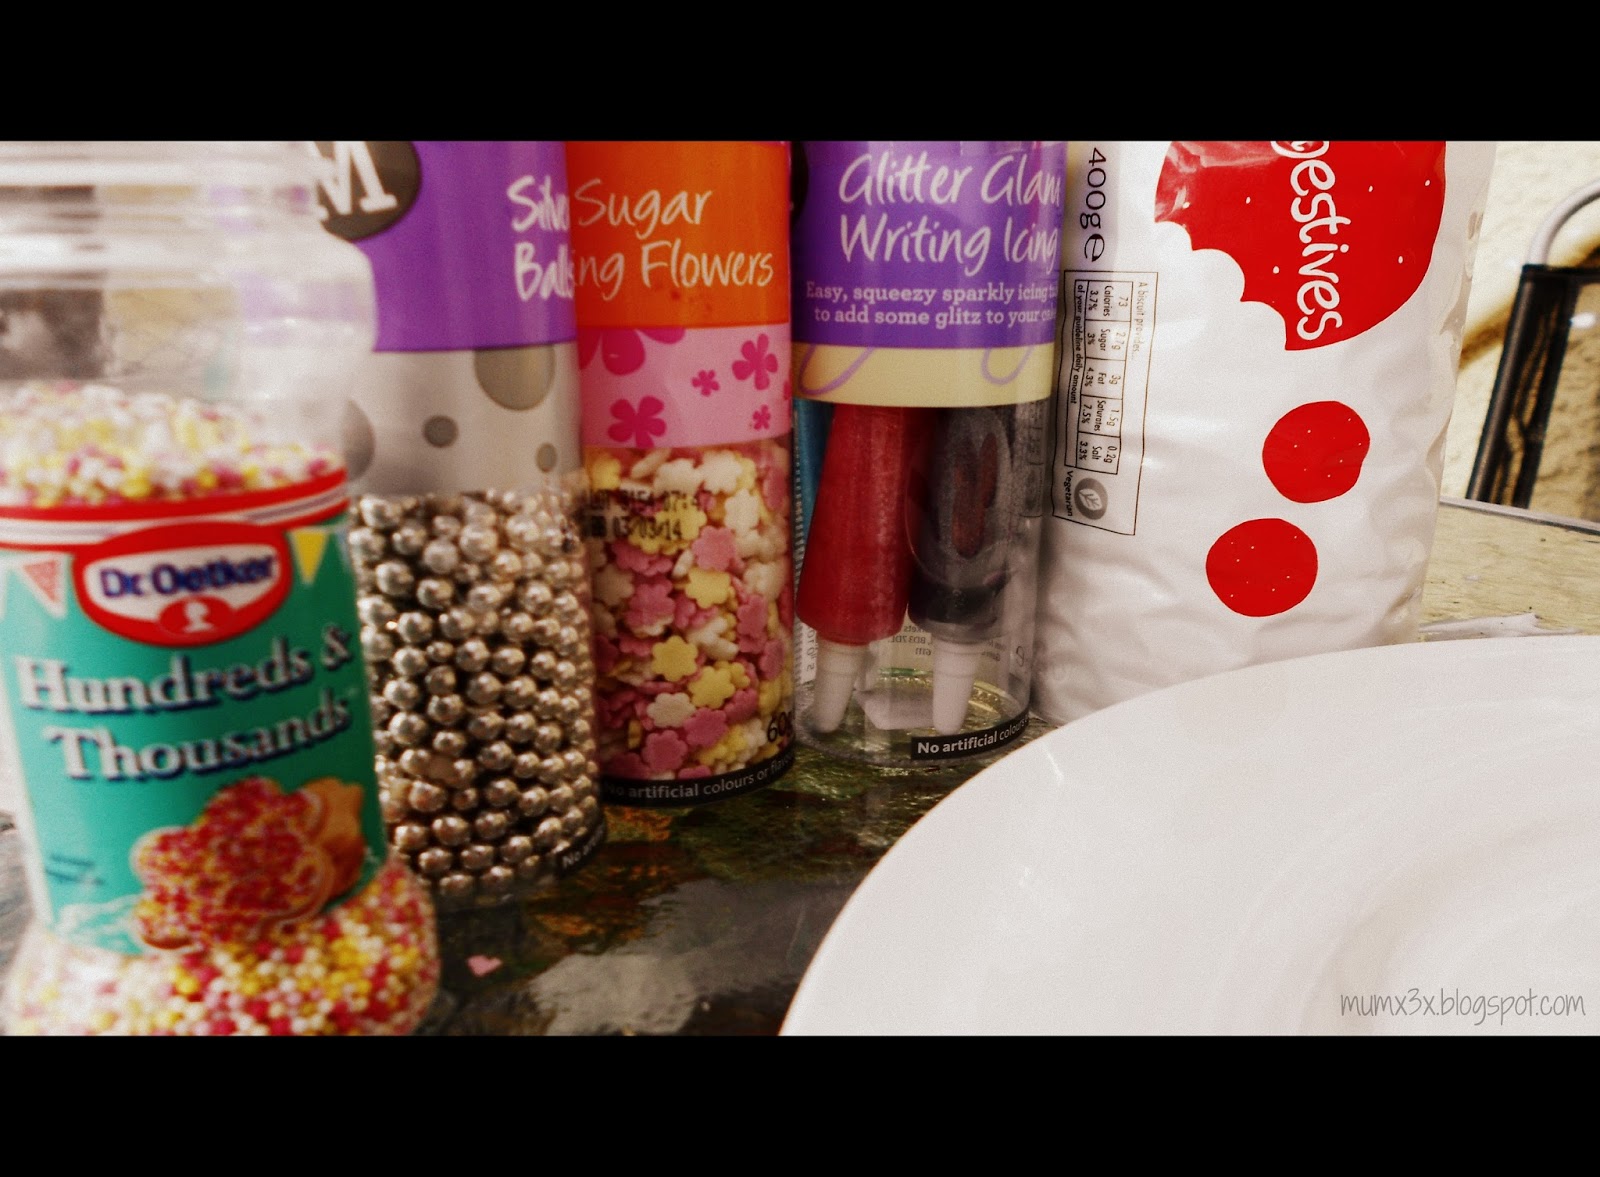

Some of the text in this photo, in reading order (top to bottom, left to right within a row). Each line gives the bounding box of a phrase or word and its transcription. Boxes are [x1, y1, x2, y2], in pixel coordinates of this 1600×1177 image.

[839, 151, 973, 206] Glitter
[574, 177, 712, 240] Sugar
[841, 212, 1058, 277] Writing Icing
[641, 239, 774, 288] Flowers
[806, 281, 848, 303] Easy,
[853, 287, 936, 305] squeezy
[942, 282, 1014, 305] sparkly
[1017, 283, 1048, 303] icing
[1077, 285, 1085, 293] of
[1088, 290, 1099, 311] 3.7%
[1075, 294, 1083, 313] your
[1103, 285, 1114, 317] Calories
[1118, 297, 1129, 307] 73
[1136, 290, 1146, 316] biscuit
[815, 306, 831, 322] to
[834, 304, 869, 322] add
[875, 310, 930, 325] some
[935, 305, 981, 329] glitz
[986, 309, 1004, 324] to
[1007, 311, 1040, 328] your
[1087, 333, 1096, 345] 3%
[1098, 329, 1111, 351] Sugar
[1073, 353, 1083, 373] daily
[1085, 367, 1095, 387] 4.3%
[1098, 372, 1107, 385] Fat
[1109, 375, 1121, 385] 3g
[1070, 374, 1079, 404] amount
[1081, 404, 1092, 424] 7.5%
[1094, 400, 1107, 431] Saturates
[1079, 440, 1088, 461] 3.3%
[1092, 446, 1102, 460] Salt
[1103, 445, 1118, 464] 0.2g
[1064, 470, 1074, 517] Vegetarian
[152, 556, 273, 596] Oetker
[15, 623, 352, 715] Hundreds &
[42, 688, 352, 782] Thousands
[917, 742, 939, 754] No
[942, 731, 998, 752] artificial
[628, 783, 699, 799] artificial
[703, 774, 755, 795] colours
[757, 768, 769, 780] or
